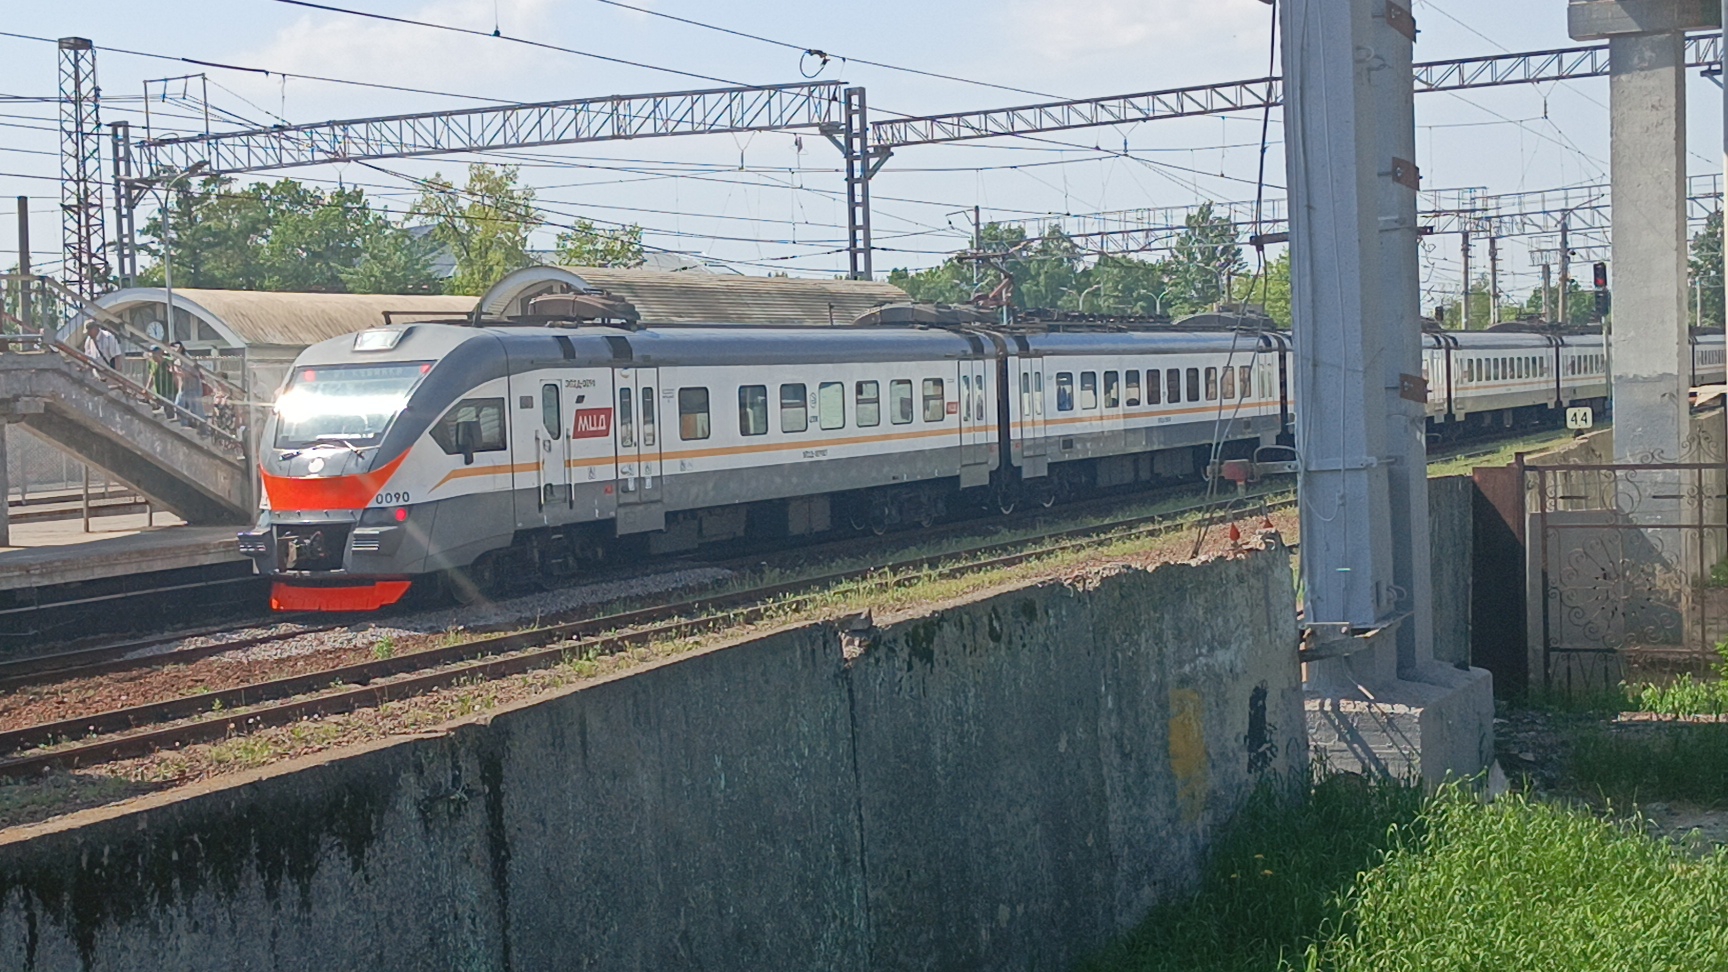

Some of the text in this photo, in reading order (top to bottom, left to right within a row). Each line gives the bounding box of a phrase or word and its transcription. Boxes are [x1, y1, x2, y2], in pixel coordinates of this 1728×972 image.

[577, 414, 607, 432] МЦД
[1570, 411, 1588, 425] 44
[375, 491, 410, 504] 0090
